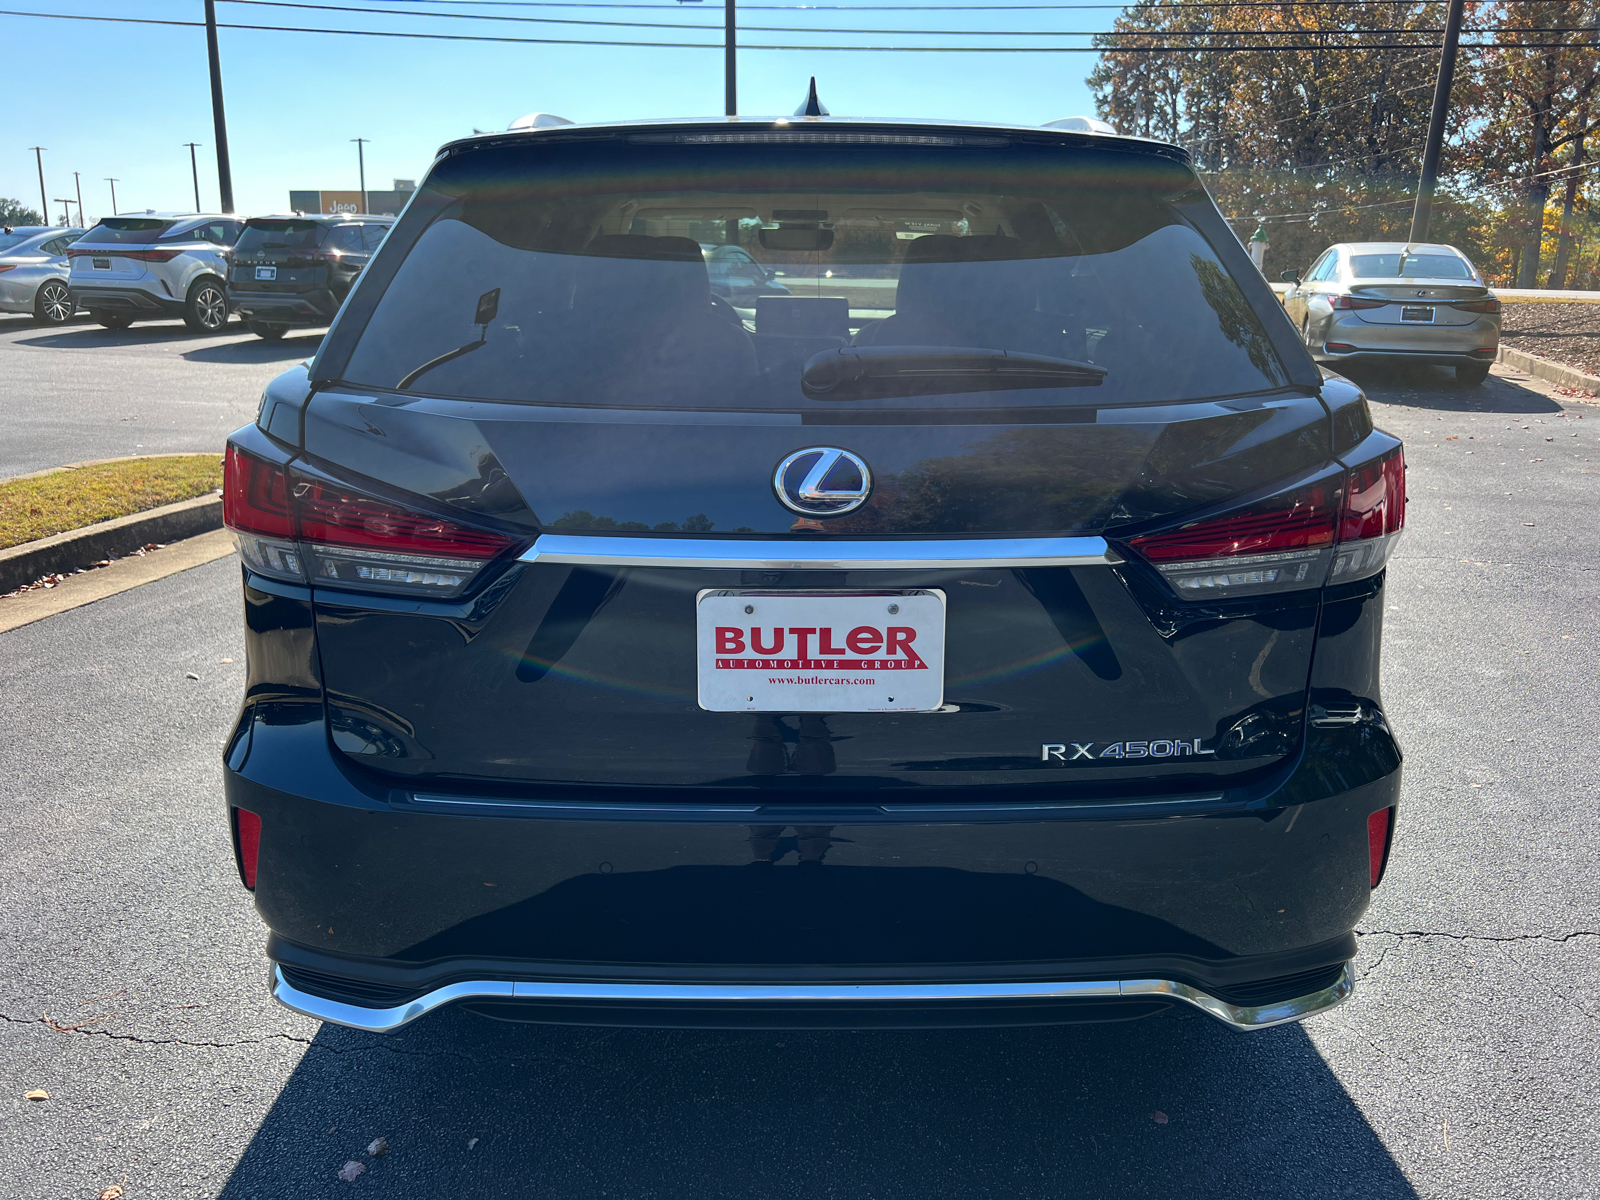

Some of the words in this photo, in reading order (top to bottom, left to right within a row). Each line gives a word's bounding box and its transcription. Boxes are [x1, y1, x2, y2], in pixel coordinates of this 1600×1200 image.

[329, 199, 358, 214] Jeep
[717, 660, 840, 669] AUTOMOTIVE
[861, 660, 921, 669] GROUP
[768, 676, 875, 686] www.butlercars.com
[1042, 742, 1096, 761] RX
[1099, 738, 1215, 759] 450hL
